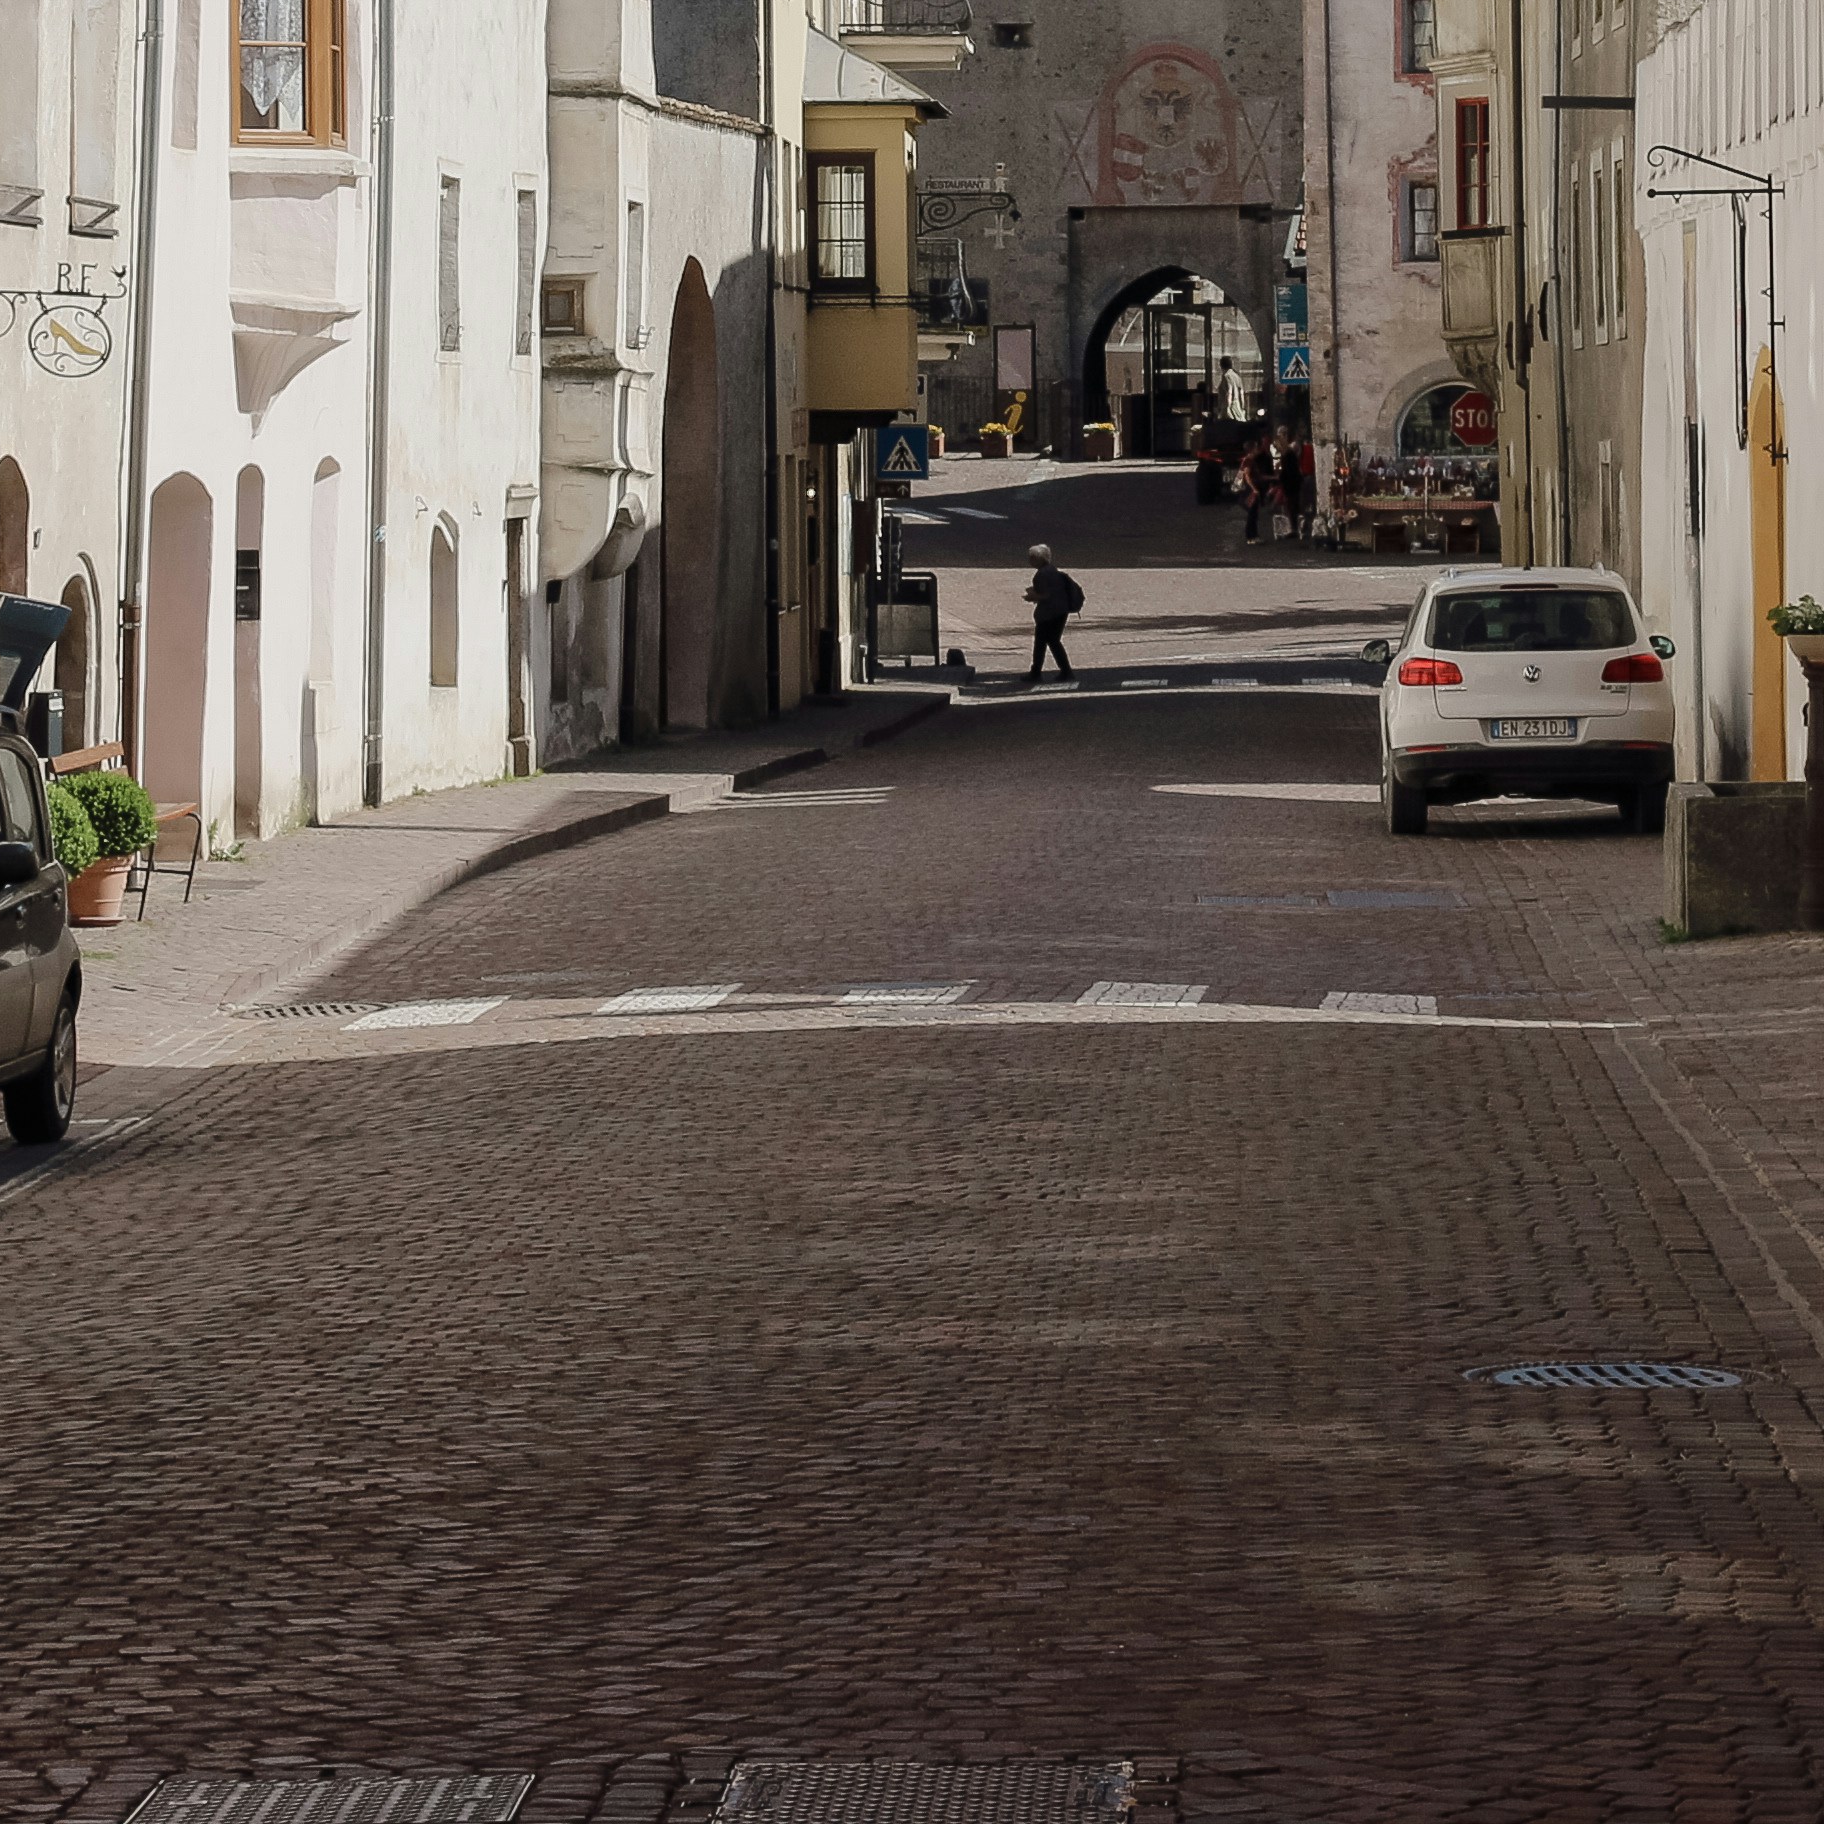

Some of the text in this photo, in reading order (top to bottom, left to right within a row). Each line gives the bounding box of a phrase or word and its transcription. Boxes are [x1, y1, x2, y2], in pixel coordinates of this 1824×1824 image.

[926, 180, 984, 190] RESTAURANT
[1501, 720, 1567, 736] EN 231DJ
